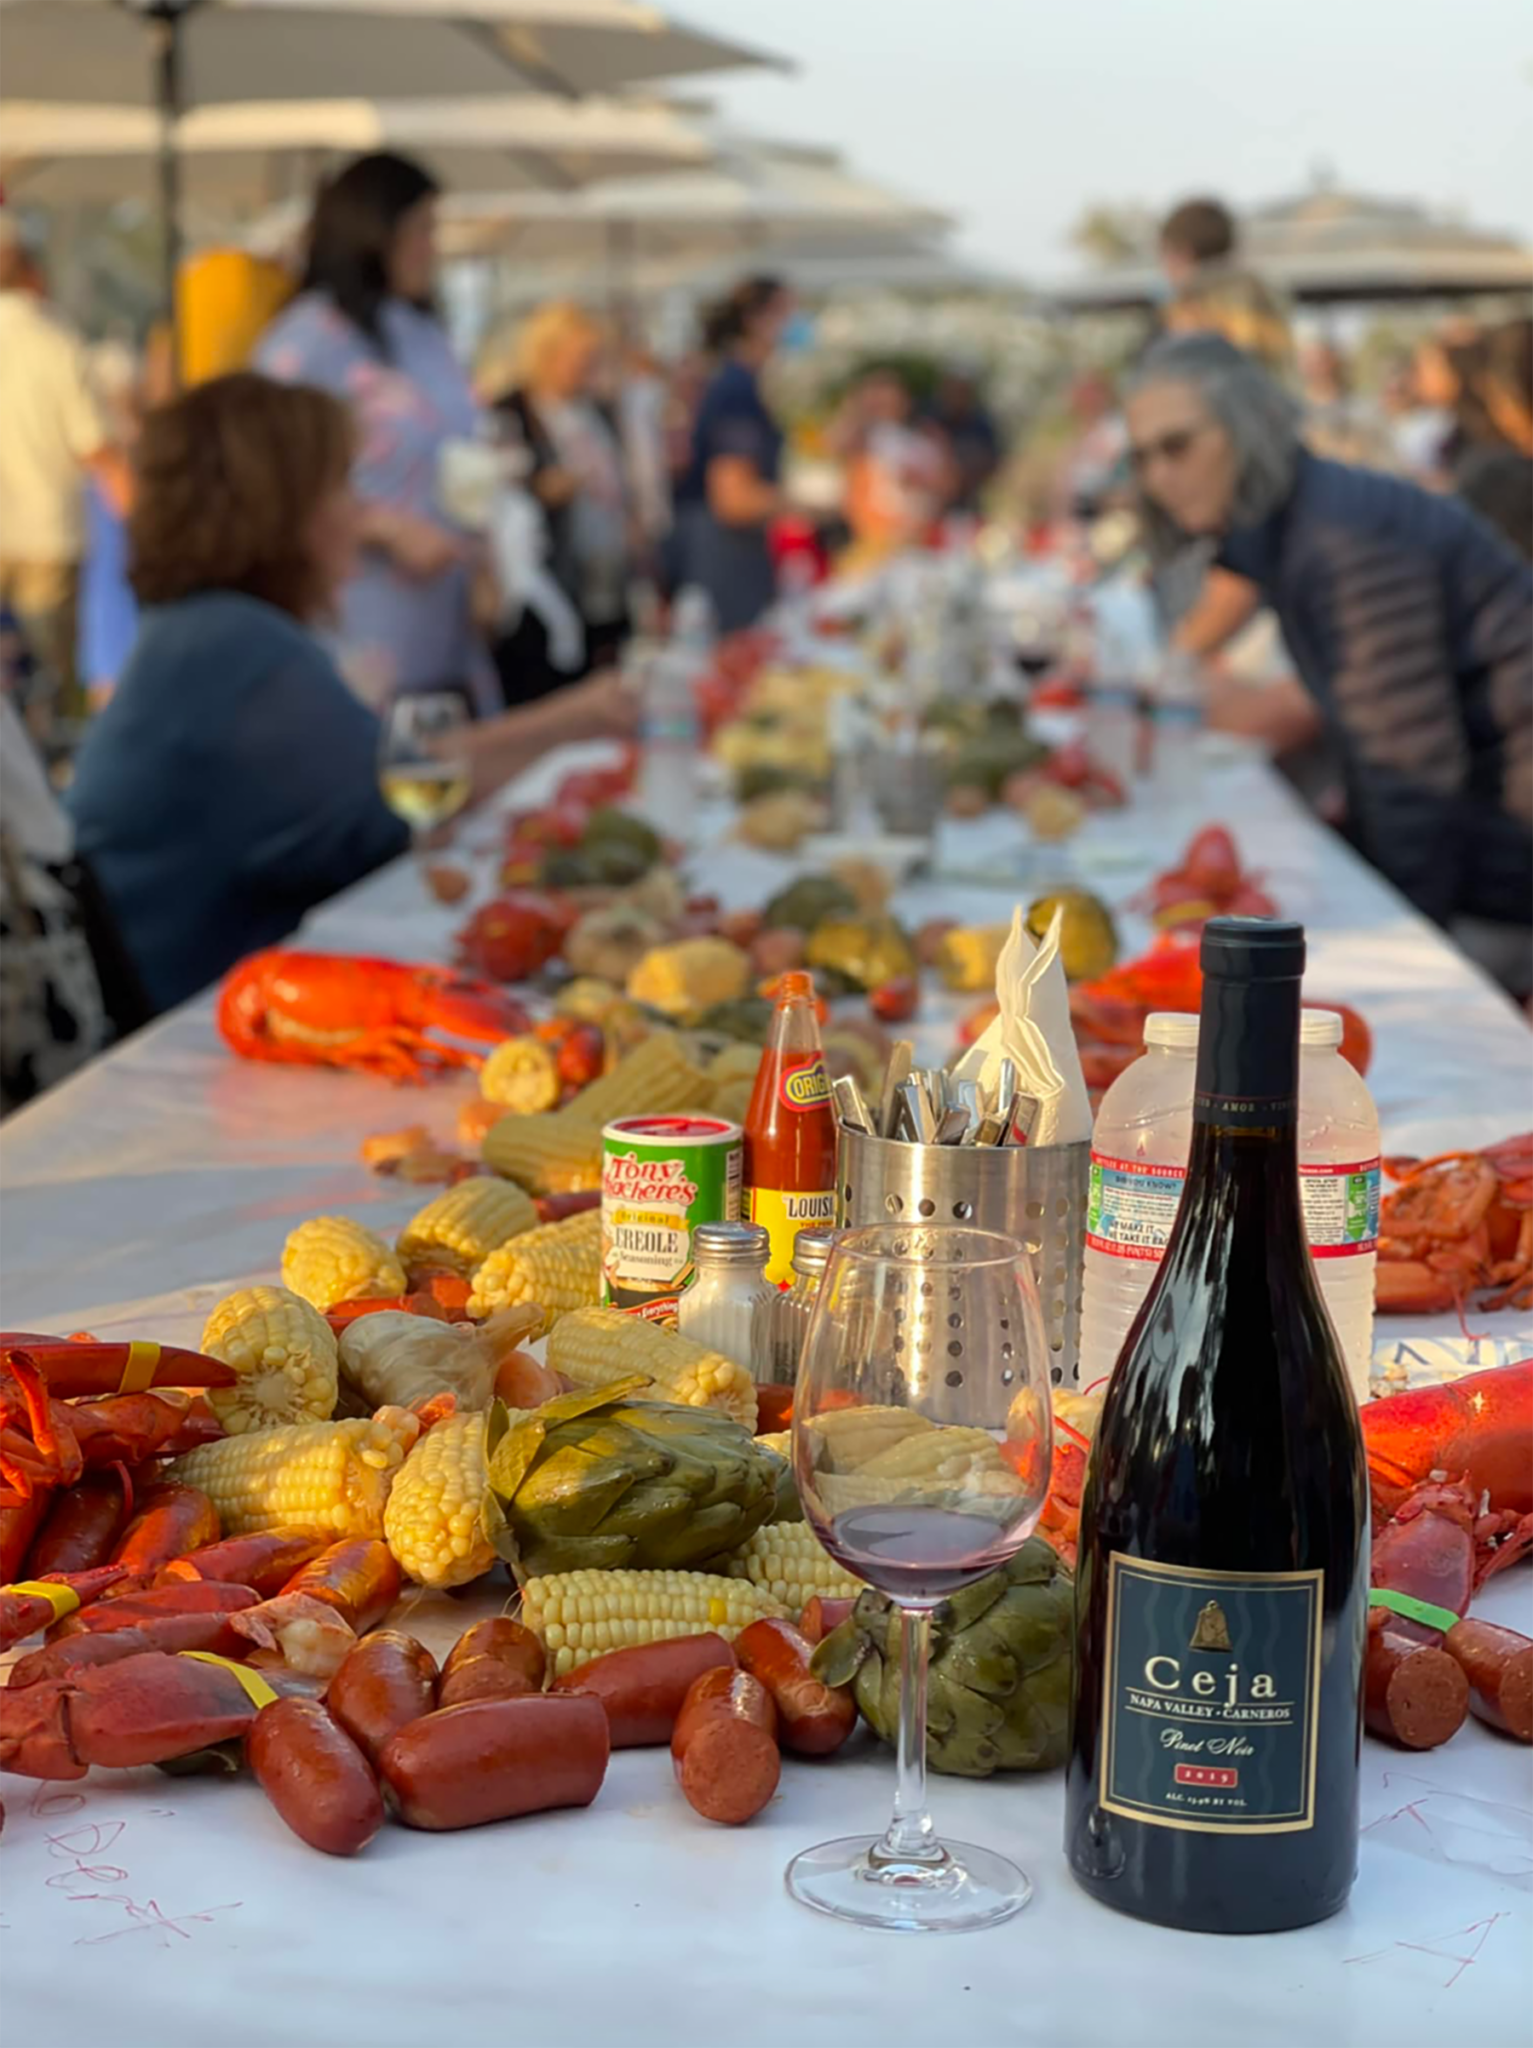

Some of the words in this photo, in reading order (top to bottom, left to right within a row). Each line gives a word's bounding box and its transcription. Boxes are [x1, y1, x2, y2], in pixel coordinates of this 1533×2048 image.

[1120, 1163, 1129, 1171] AT
[1133, 1165, 1148, 1174] THE
[1152, 1167, 1184, 1178] SOURCE
[620, 1210, 670, 1225] Original
[1120, 1221, 1145, 1233] MAKE
[1146, 1224, 1155, 1234] IT
[615, 1227, 679, 1254] CREOLE
[1119, 1231, 1140, 1243] TAKE
[1141, 1234, 1151, 1244] IT
[620, 1250, 673, 1267] Seasoning
[1144, 1655, 1277, 1709] Ceja
[1129, 1693, 1162, 1711] NAPA
[1163, 1701, 1215, 1718] VALLEY
[1222, 1707, 1291, 1721] CARNEROS
[1160, 1728, 1205, 1752] Pinot
[1207, 1737, 1254, 1755] Noir
[1185, 1770, 1228, 1783] 2019
[1165, 1792, 1186, 1803] ALC.
[1212, 1798, 1225, 1806] BY
[1227, 1798, 1249, 1807] VOL.
